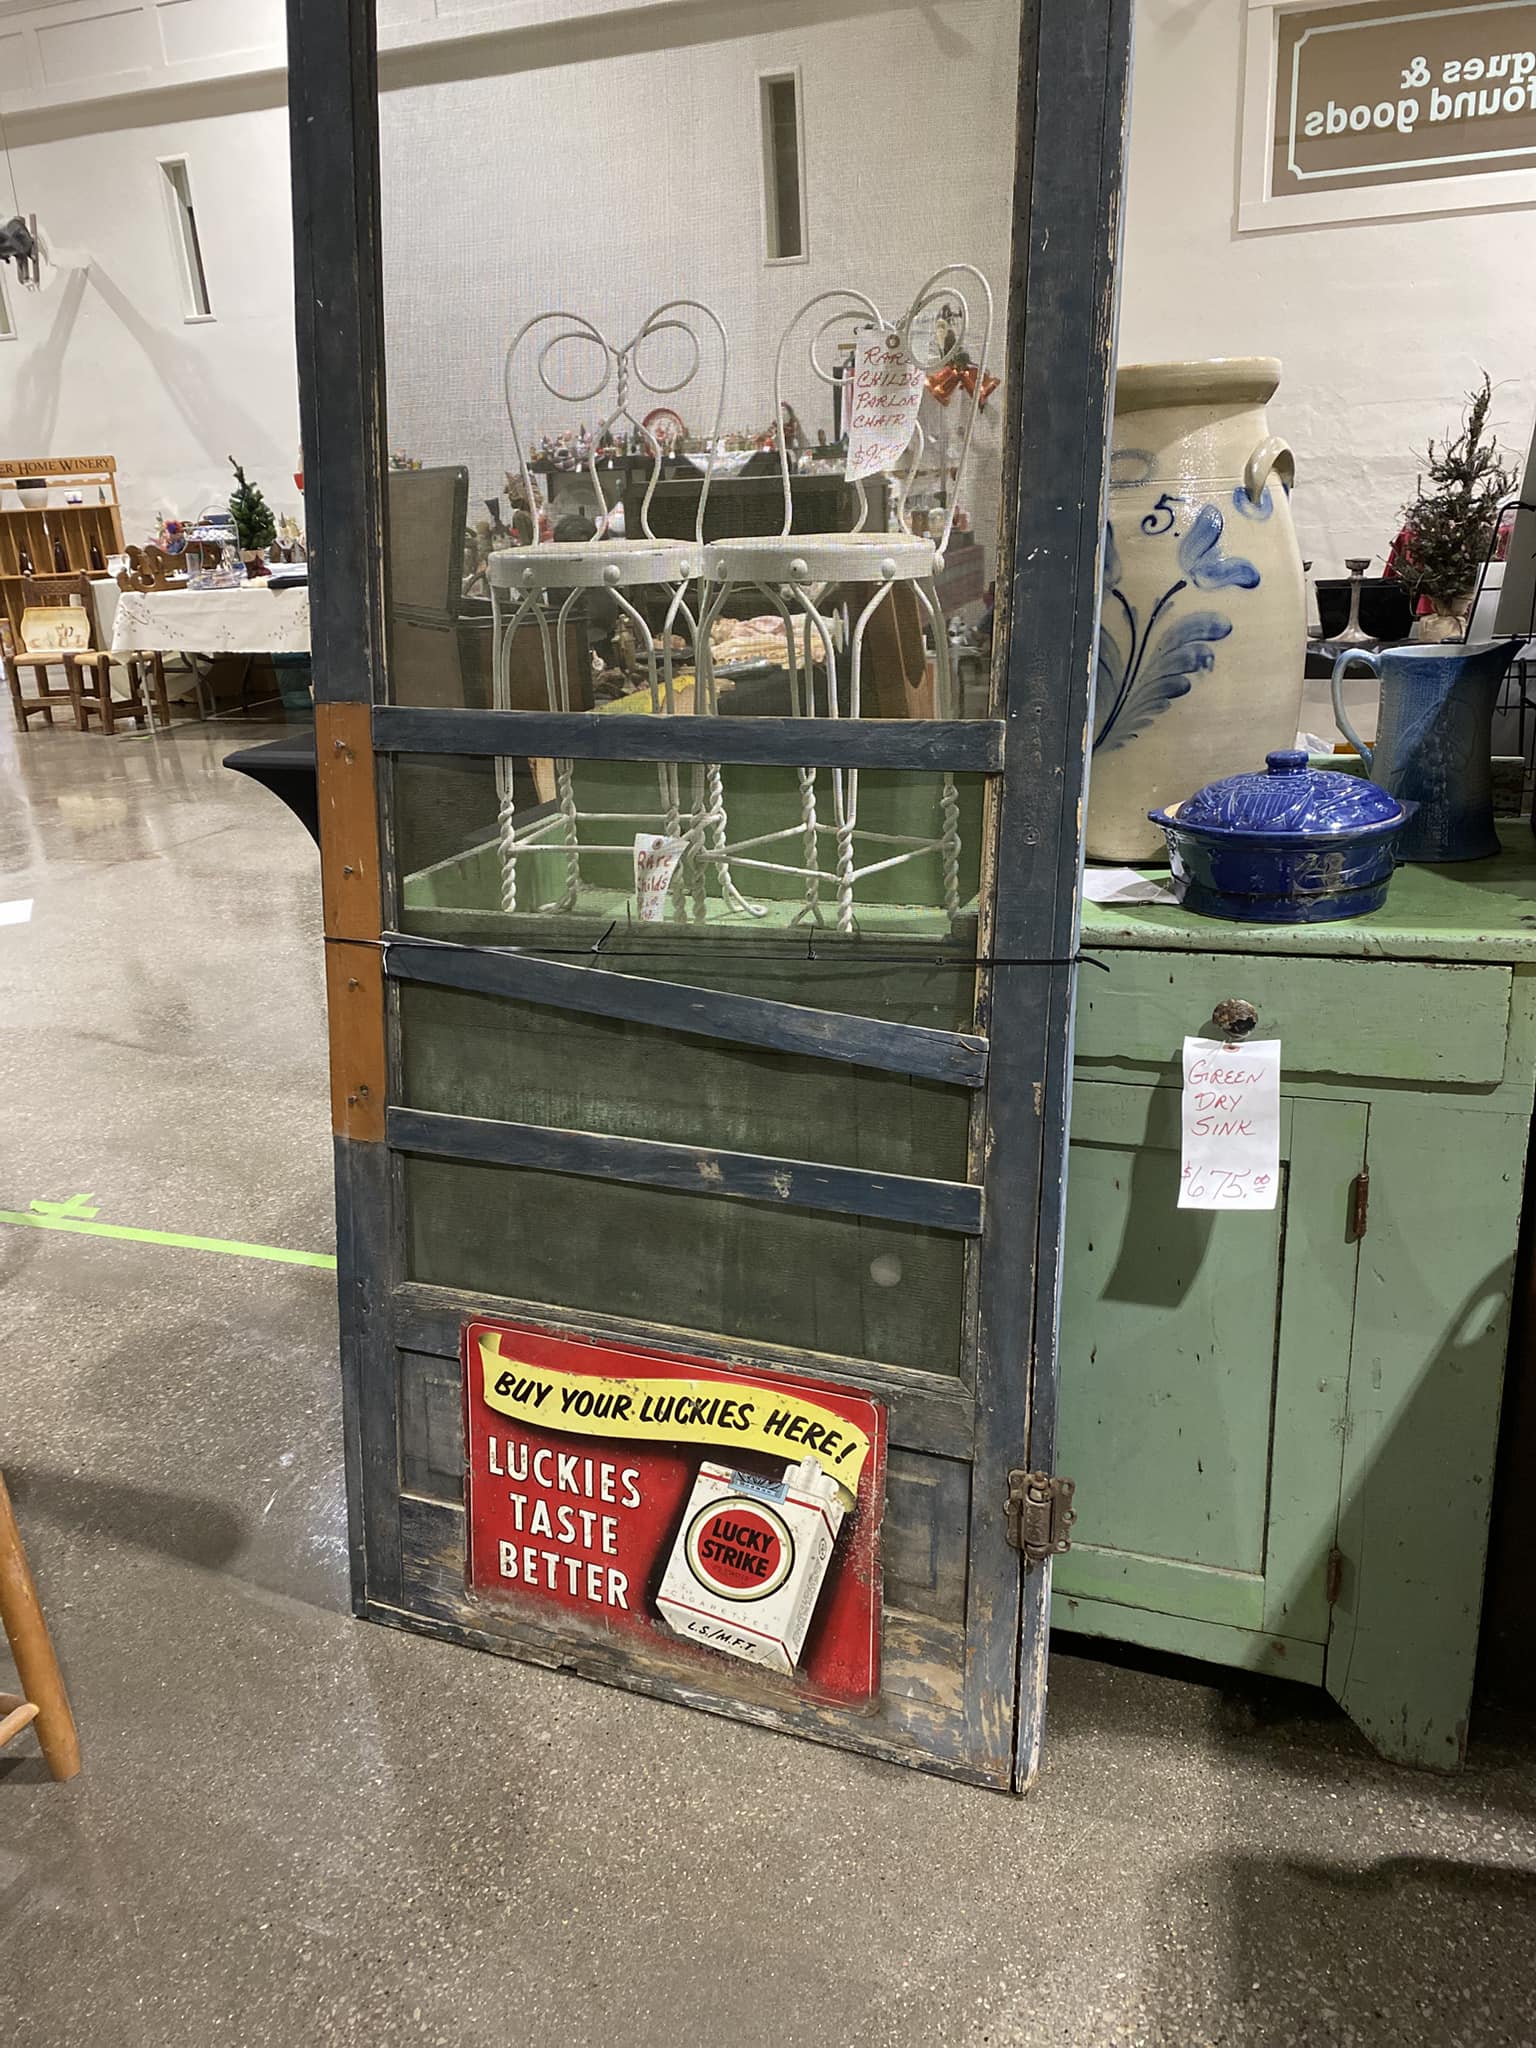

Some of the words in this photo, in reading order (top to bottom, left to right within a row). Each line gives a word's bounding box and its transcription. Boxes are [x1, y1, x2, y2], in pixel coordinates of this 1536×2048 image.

[863, 346, 913, 366] RAR
[855, 391, 919, 411] PARLOR
[853, 414, 905, 429] CHAIR
[18, 461, 56, 475] HOME
[59, 458, 110, 472] WINERY
[1188, 1059, 1264, 1085] GREEN
[1194, 1091, 1243, 1112] DRY
[1191, 1116, 1256, 1136] SINK
[494, 1371, 553, 1408] BUY
[560, 1386, 638, 1421] YOUR
[639, 1395, 755, 1431] LUCKIES
[763, 1408, 858, 1465] HERE!
[488, 1436, 643, 1509] LUCKIES
[509, 1493, 618, 1556] TASTE
[712, 1517, 776, 1554] LUCKY
[701, 1539, 770, 1578] STRIKE
[499, 1540, 630, 1611] BETTER
[687, 1620, 758, 1654] L.S./M.F.T.
